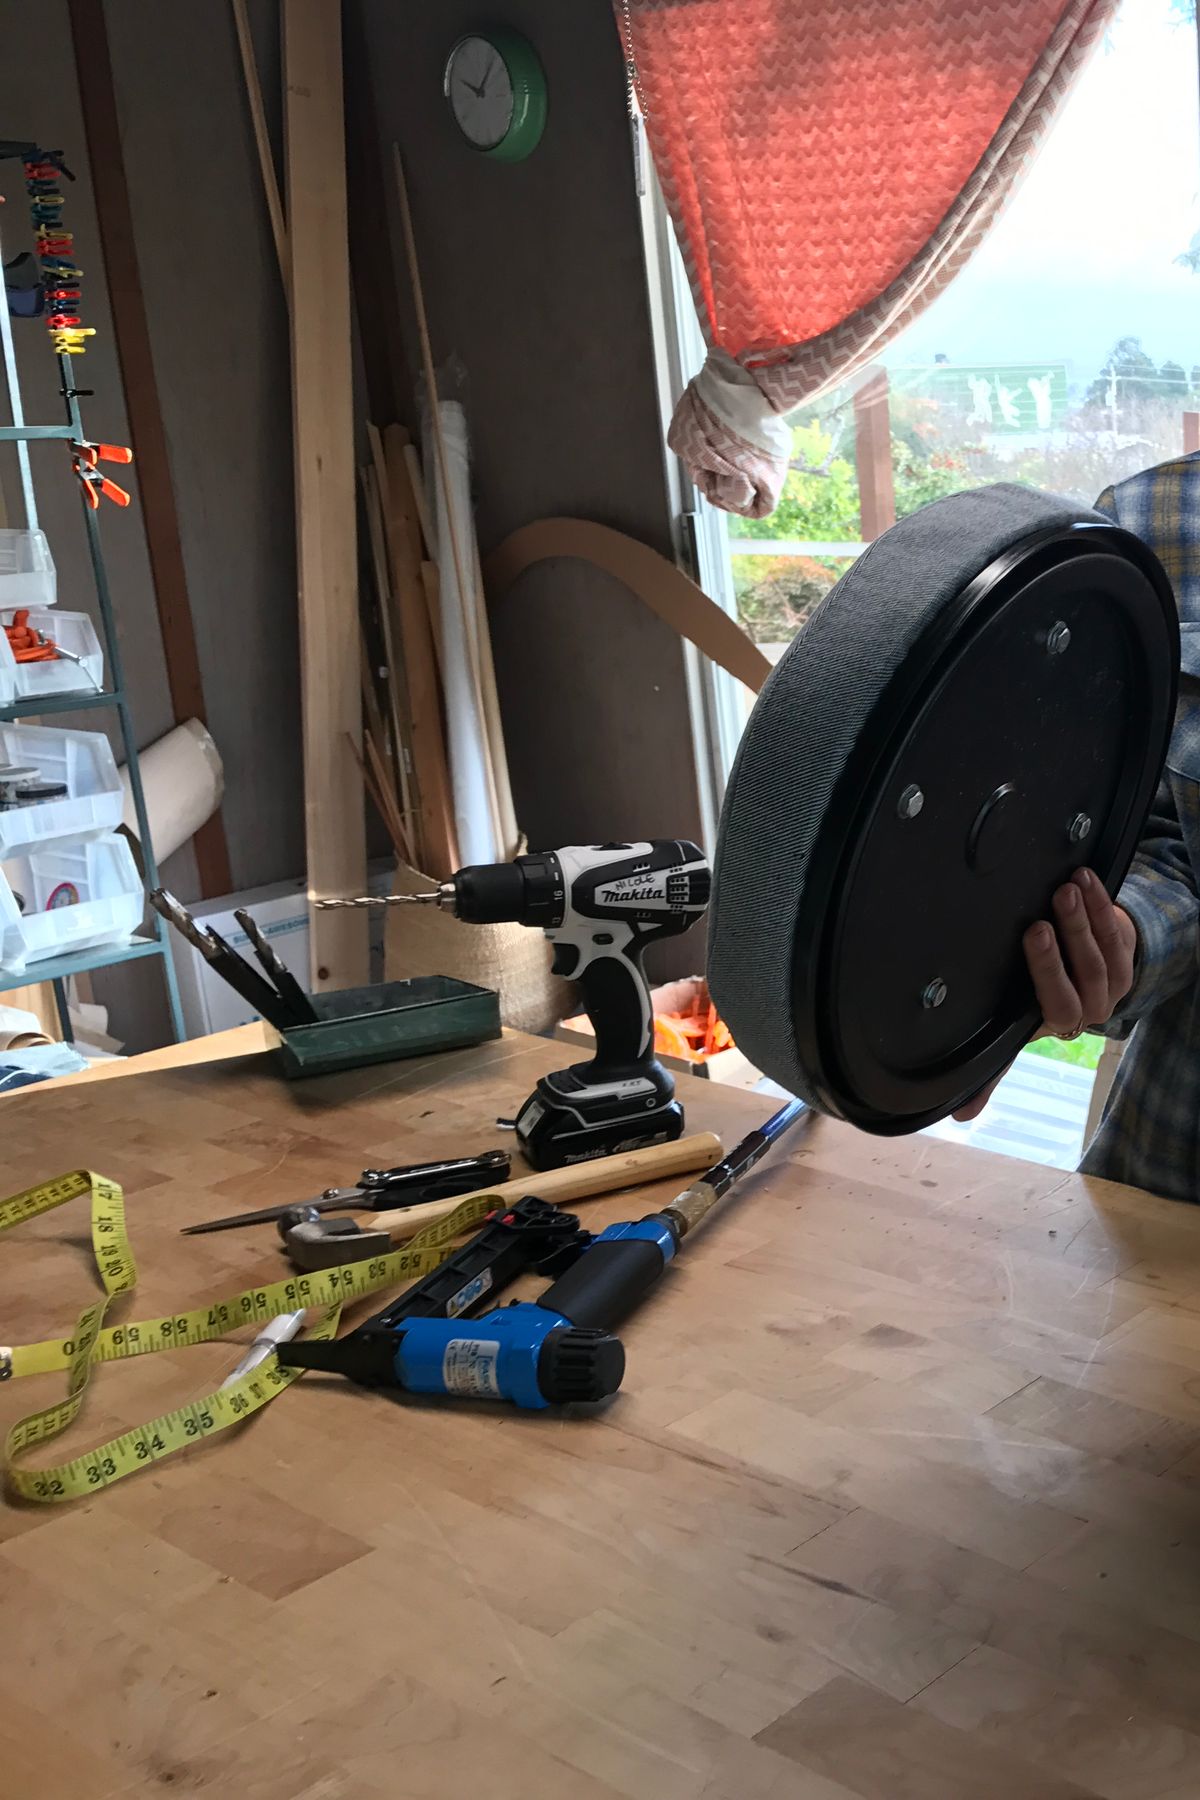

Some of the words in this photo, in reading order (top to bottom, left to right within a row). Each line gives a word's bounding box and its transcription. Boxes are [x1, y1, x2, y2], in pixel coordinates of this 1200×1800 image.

[98, 1216, 113, 1232] 18
[105, 1259, 124, 1277] 20
[368, 1261, 387, 1279] 53
[400, 1253, 422, 1270] 52
[328, 1269, 354, 1289] 54
[284, 1279, 310, 1300] 55
[241, 1292, 267, 1313] 56
[207, 1305, 229, 1326] 57
[112, 1327, 140, 1345] 59
[160, 1318, 188, 1337] 58
[33, 1480, 65, 1497] 32
[86, 1457, 117, 1484] 33
[134, 1433, 166, 1460] 34
[183, 1411, 214, 1437] 35
